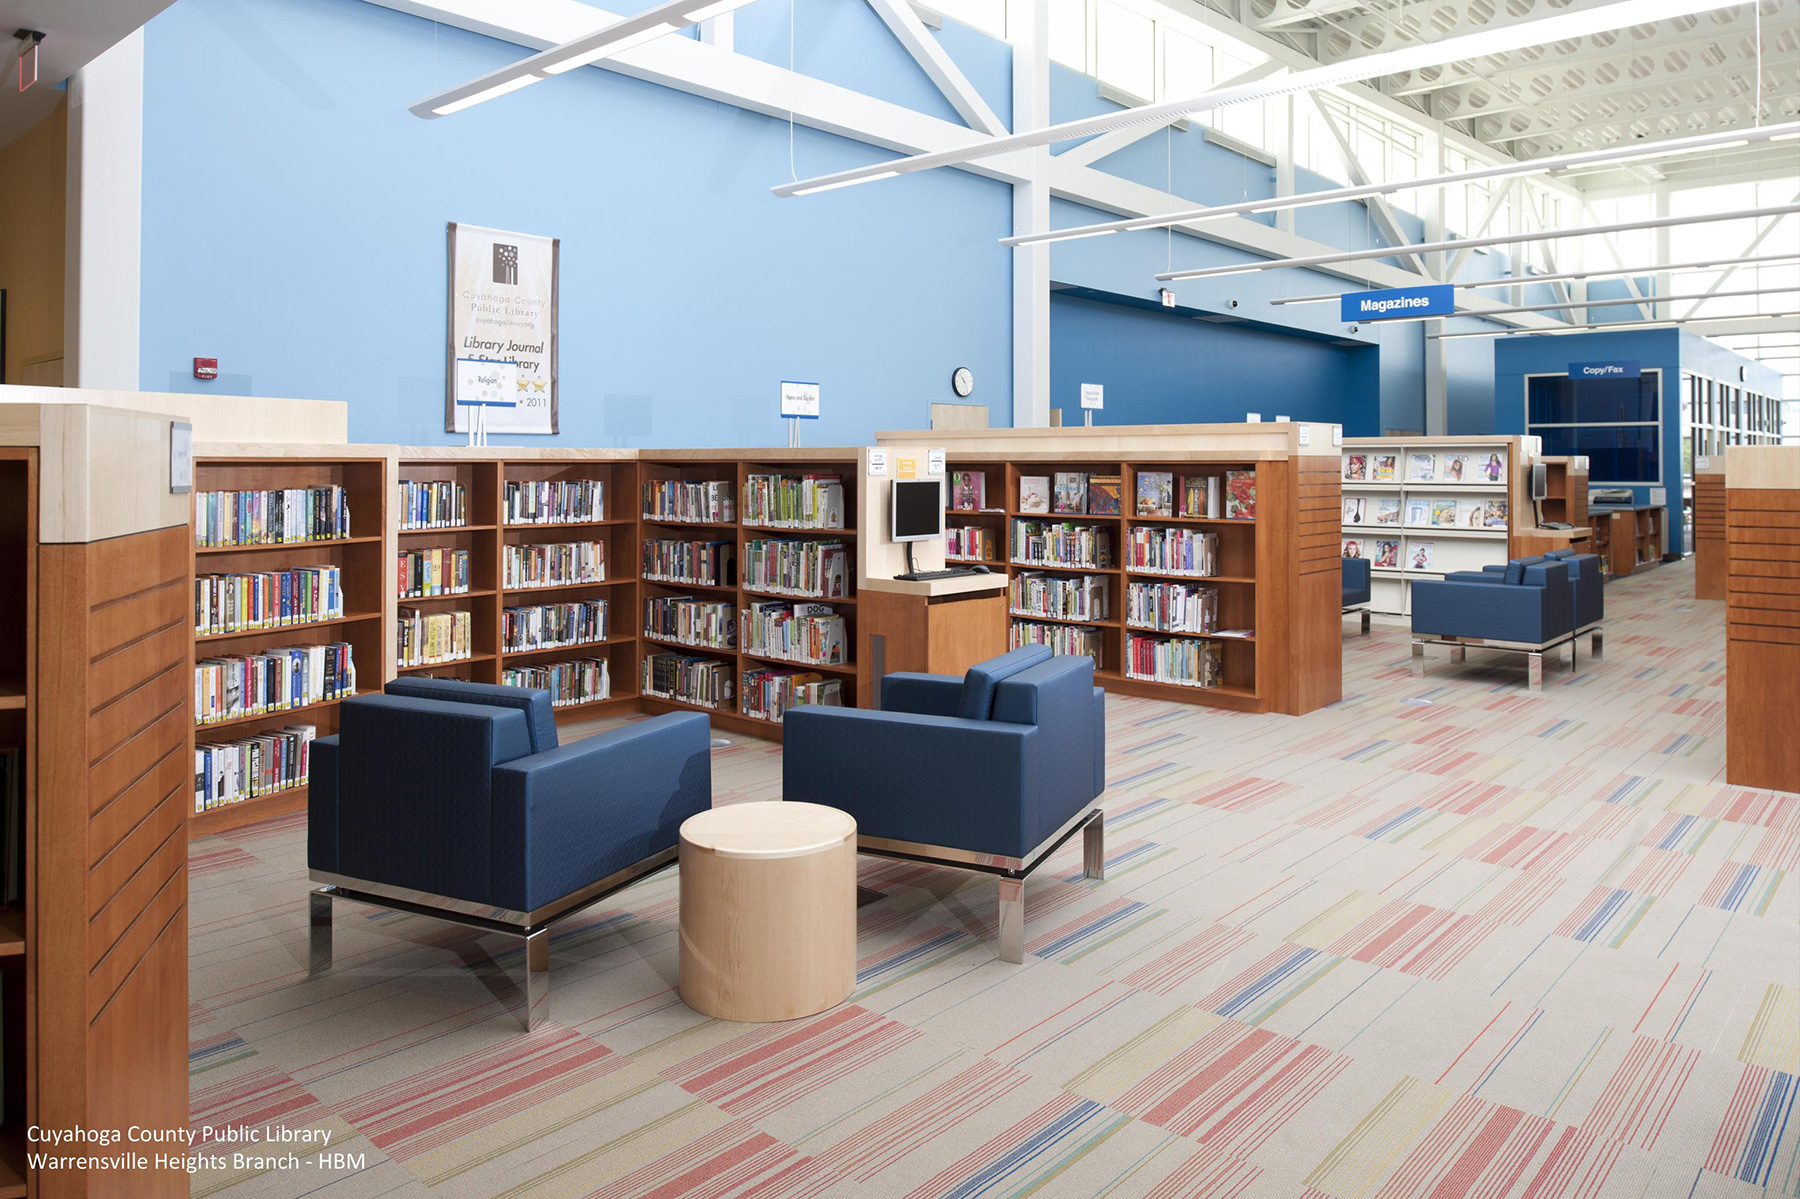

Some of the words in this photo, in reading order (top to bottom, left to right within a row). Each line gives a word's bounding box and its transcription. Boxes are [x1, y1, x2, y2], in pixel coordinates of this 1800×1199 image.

[463, 291, 511, 304] Cuyahoga
[514, 297, 546, 308] County
[1361, 295, 1429, 313] Magazines
[471, 303, 501, 314] Public
[505, 307, 539, 319] Library
[464, 336, 504, 354] Library
[507, 340, 544, 354] Journal
[1583, 365, 1624, 376] Copy/Fax
[478, 376, 497, 385] Religion
[527, 397, 546, 407] 2011
[807, 605, 825, 613] DOG
